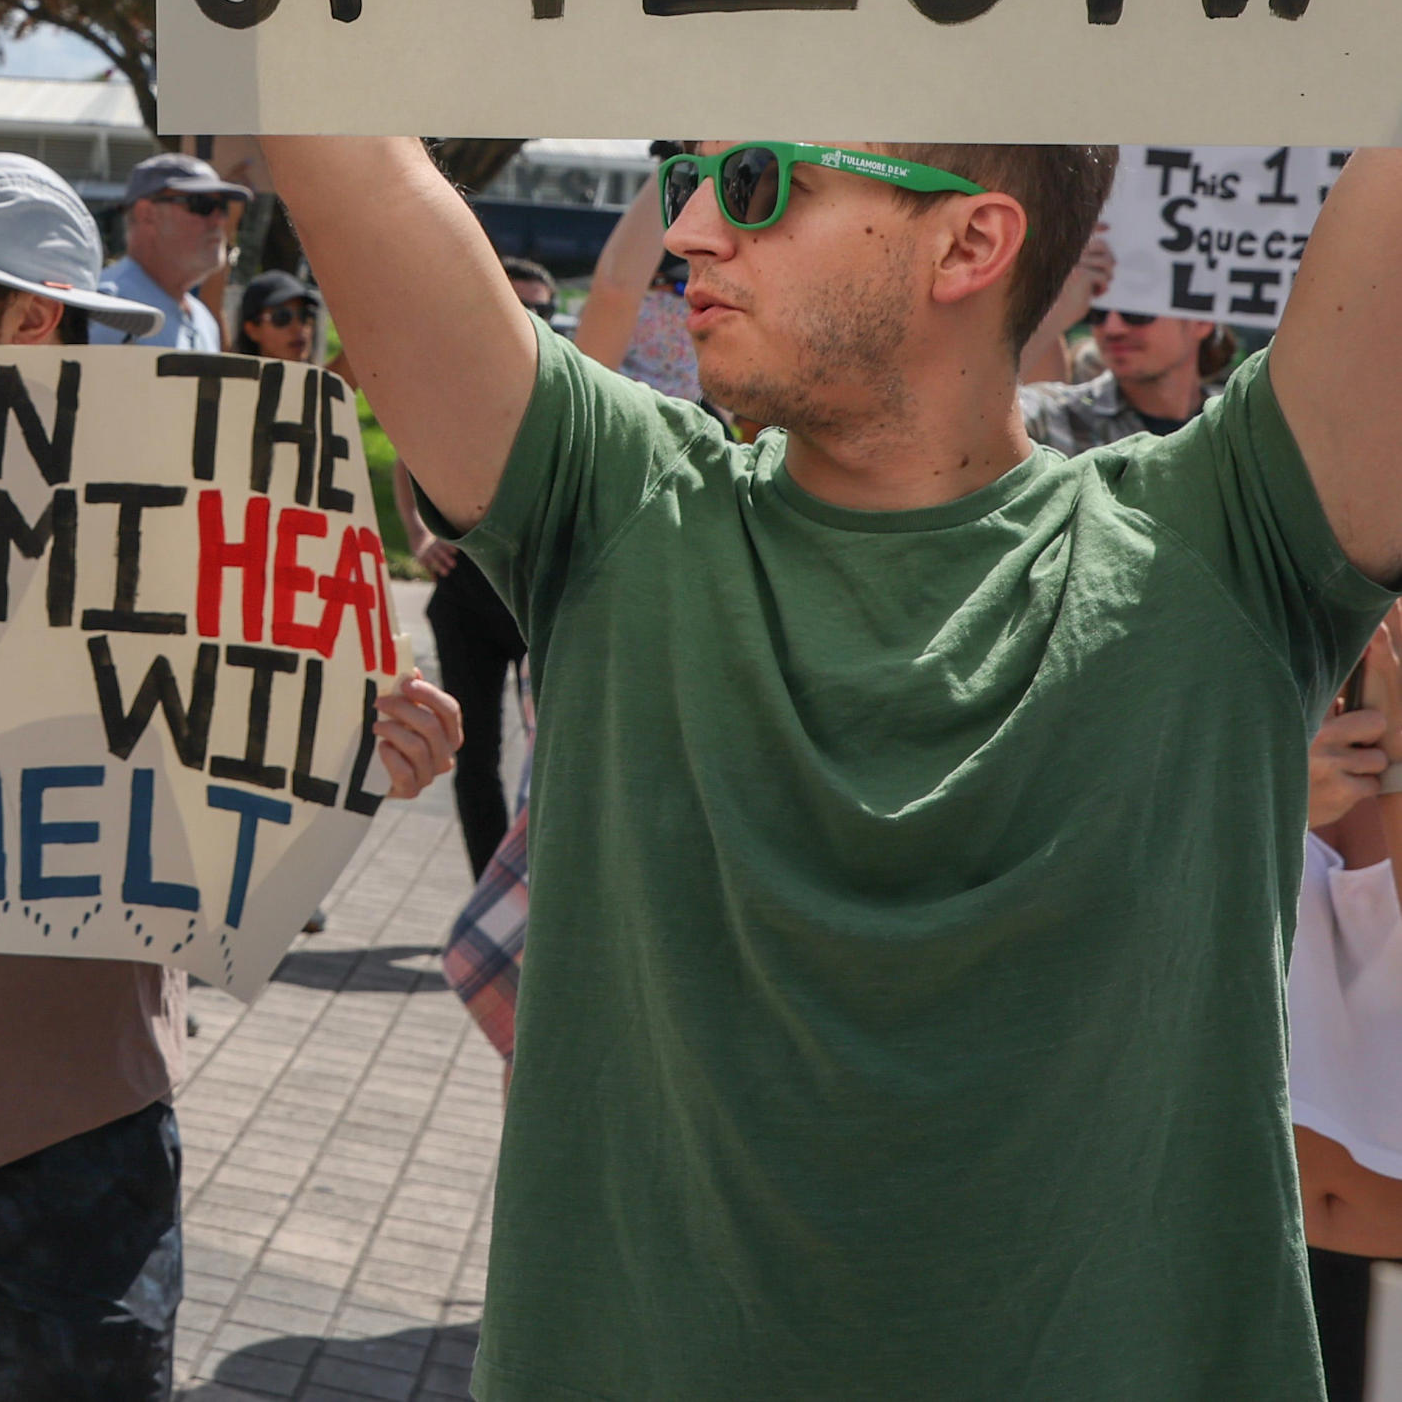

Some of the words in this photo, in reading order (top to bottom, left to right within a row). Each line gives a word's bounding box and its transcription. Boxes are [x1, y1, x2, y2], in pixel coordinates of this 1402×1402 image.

[842, 155, 887, 170] TULLAMORE
[1146, 147, 1241, 200] This
[1169, 262, 1296, 316] LI
[156, 353, 355, 513] THE
[84, 634, 388, 816] WILL
